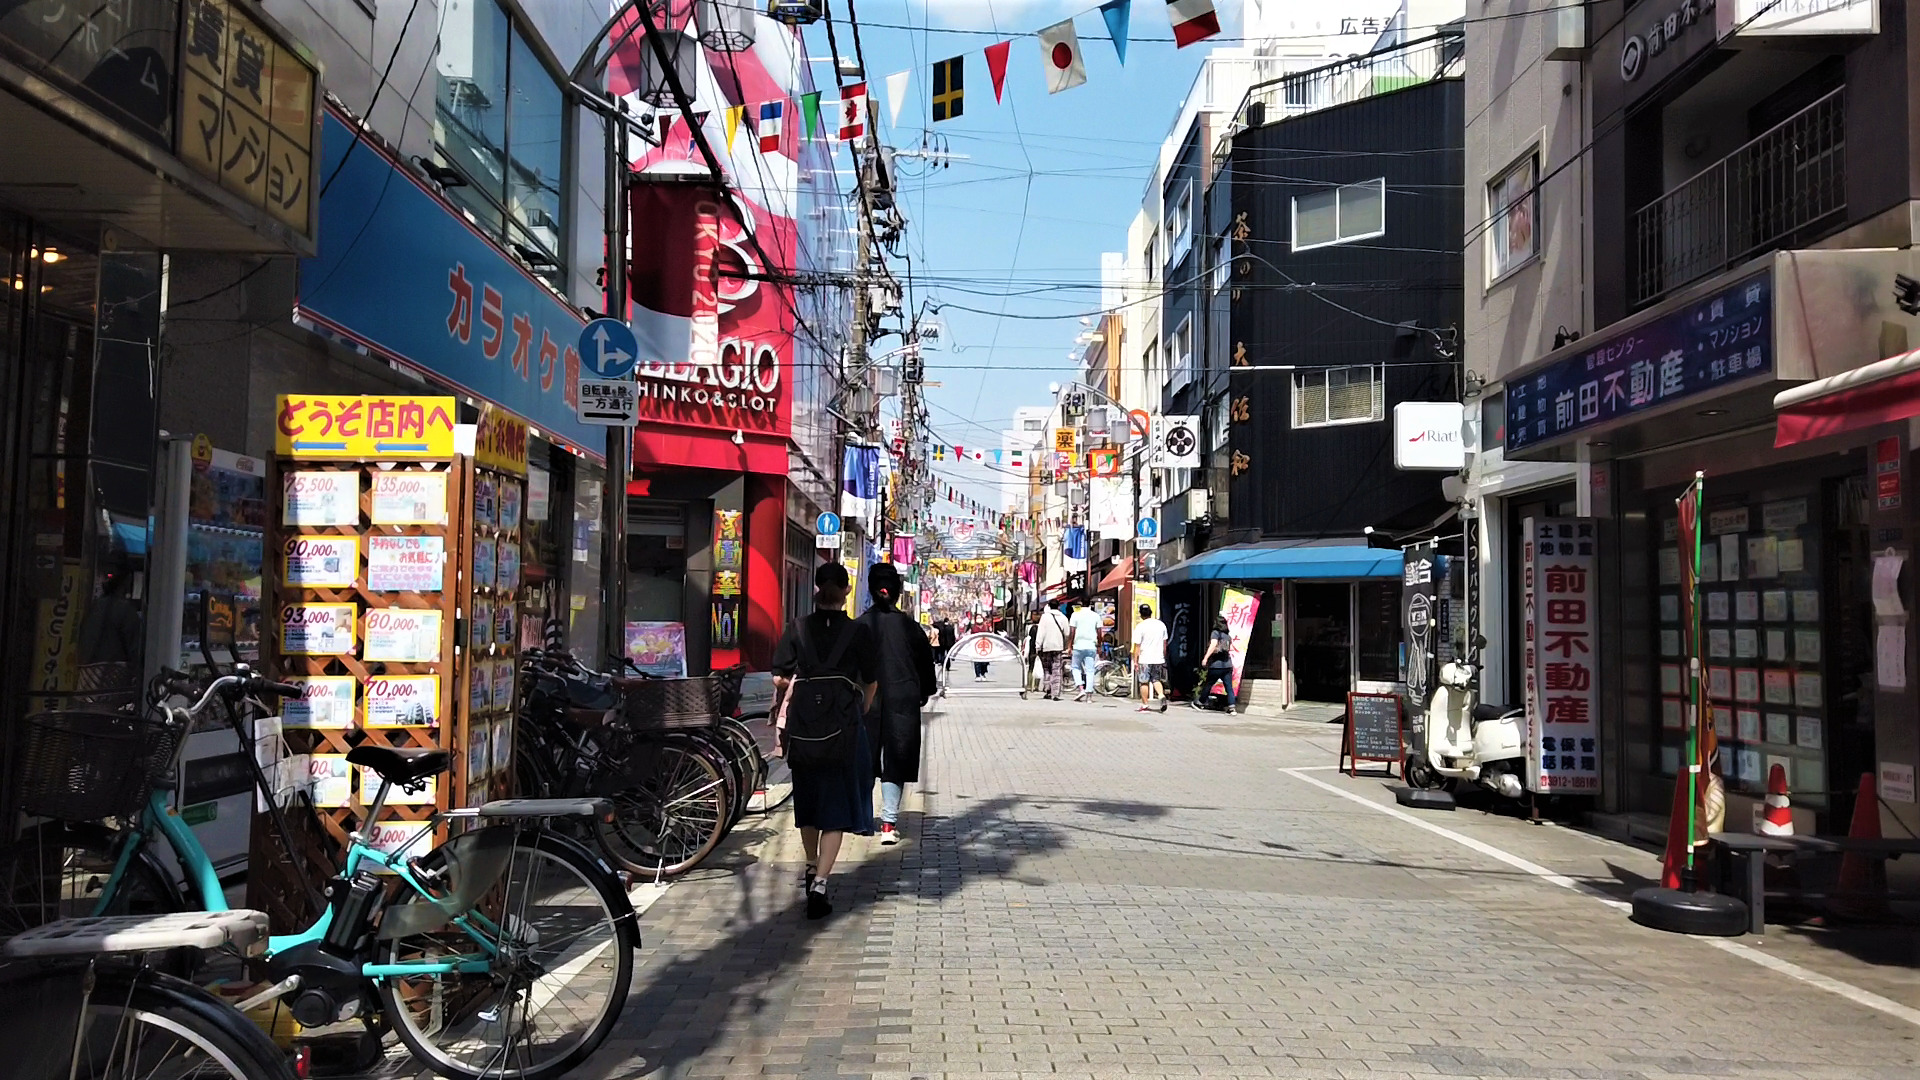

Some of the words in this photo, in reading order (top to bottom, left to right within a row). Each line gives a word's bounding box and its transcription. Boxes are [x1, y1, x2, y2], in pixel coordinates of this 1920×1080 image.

[197, 92, 303, 211] マンション
[690, 289, 718, 363] 2020
[1709, 316, 1763, 350] マンション
[1710, 345, 1762, 381] 駐車場
[582, 384, 632, 397] 自転車を除く
[582, 398, 633, 410] 一方通行
[1554, 348, 1686, 431] 前田不動産
[1539, 525, 1554, 556] 土地
[1544, 564, 1591, 724] 前田不動産
